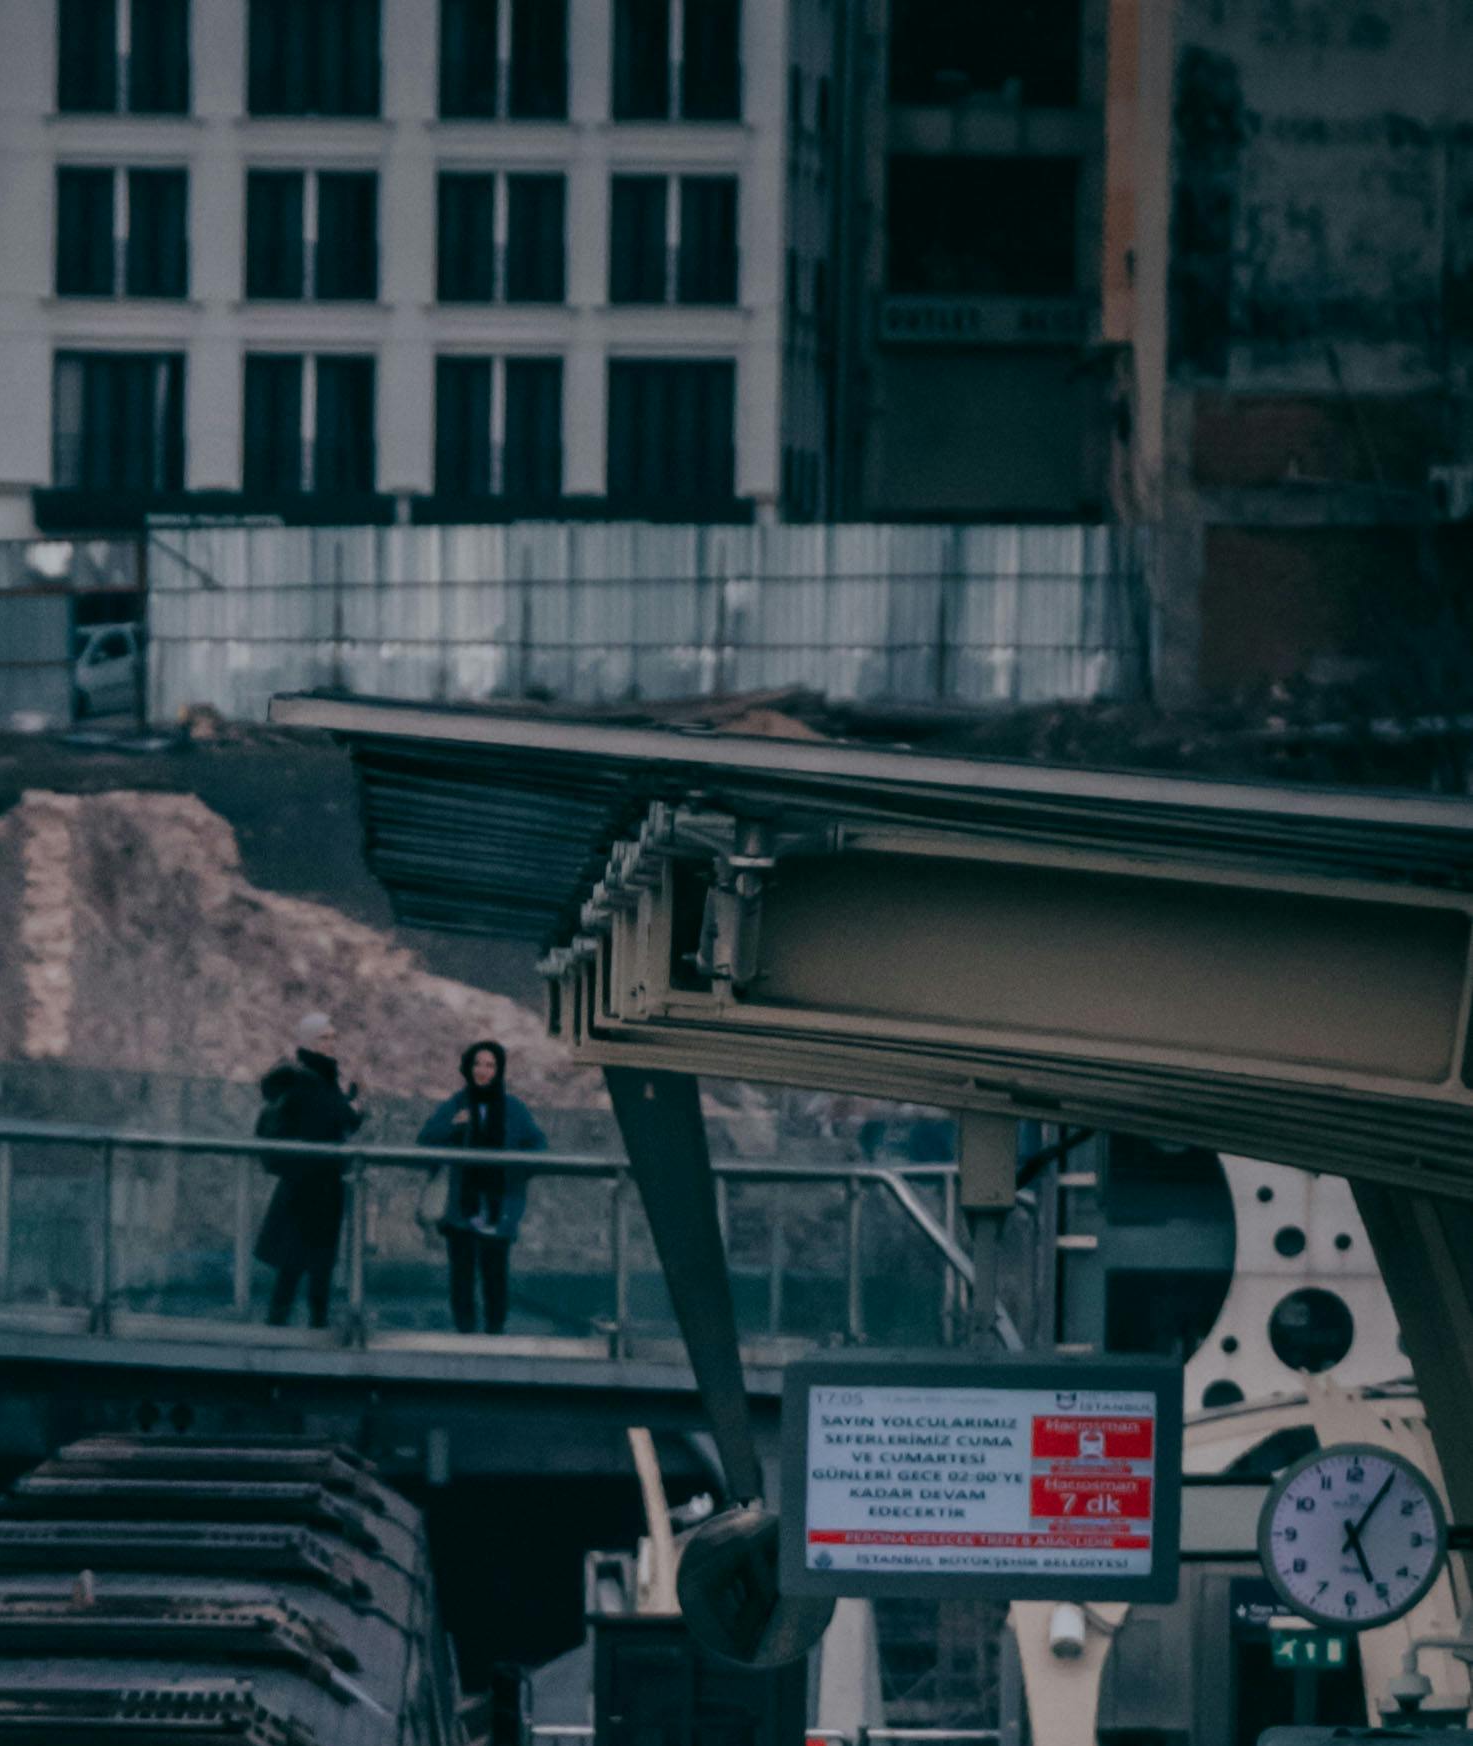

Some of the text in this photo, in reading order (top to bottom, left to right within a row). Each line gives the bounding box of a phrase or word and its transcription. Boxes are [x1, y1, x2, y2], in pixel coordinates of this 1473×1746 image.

[821, 1415, 1017, 1429] SAYIN YOLCULARIMIZ
[824, 1432, 1013, 1448] SEFERLERİMİZ CUMA
[852, 1451, 986, 1464] VE CUMARTESİ
[812, 1466, 891, 1481] GÜNLERİ
[898, 1471, 942, 1482] GECE
[1347, 1467, 1364, 1482] 12
[1321, 1476, 1332, 1490] 11
[850, 1487, 986, 1501] KADAR DEVAM
[1060, 1492, 1121, 1513] 7 dk
[1296, 1497, 1315, 1512] 10
[1401, 1500, 1414, 1516] 2
[868, 1505, 966, 1519] EDECEKTİR
[1285, 1527, 1297, 1541] 9
[1410, 1532, 1422, 1548] 3
[1293, 1558, 1306, 1573] 8
[1396, 1566, 1409, 1577] 4
[1317, 1581, 1329, 1593] 7
[1376, 1583, 1388, 1598] 5
[1344, 1592, 1357, 1605] 6
